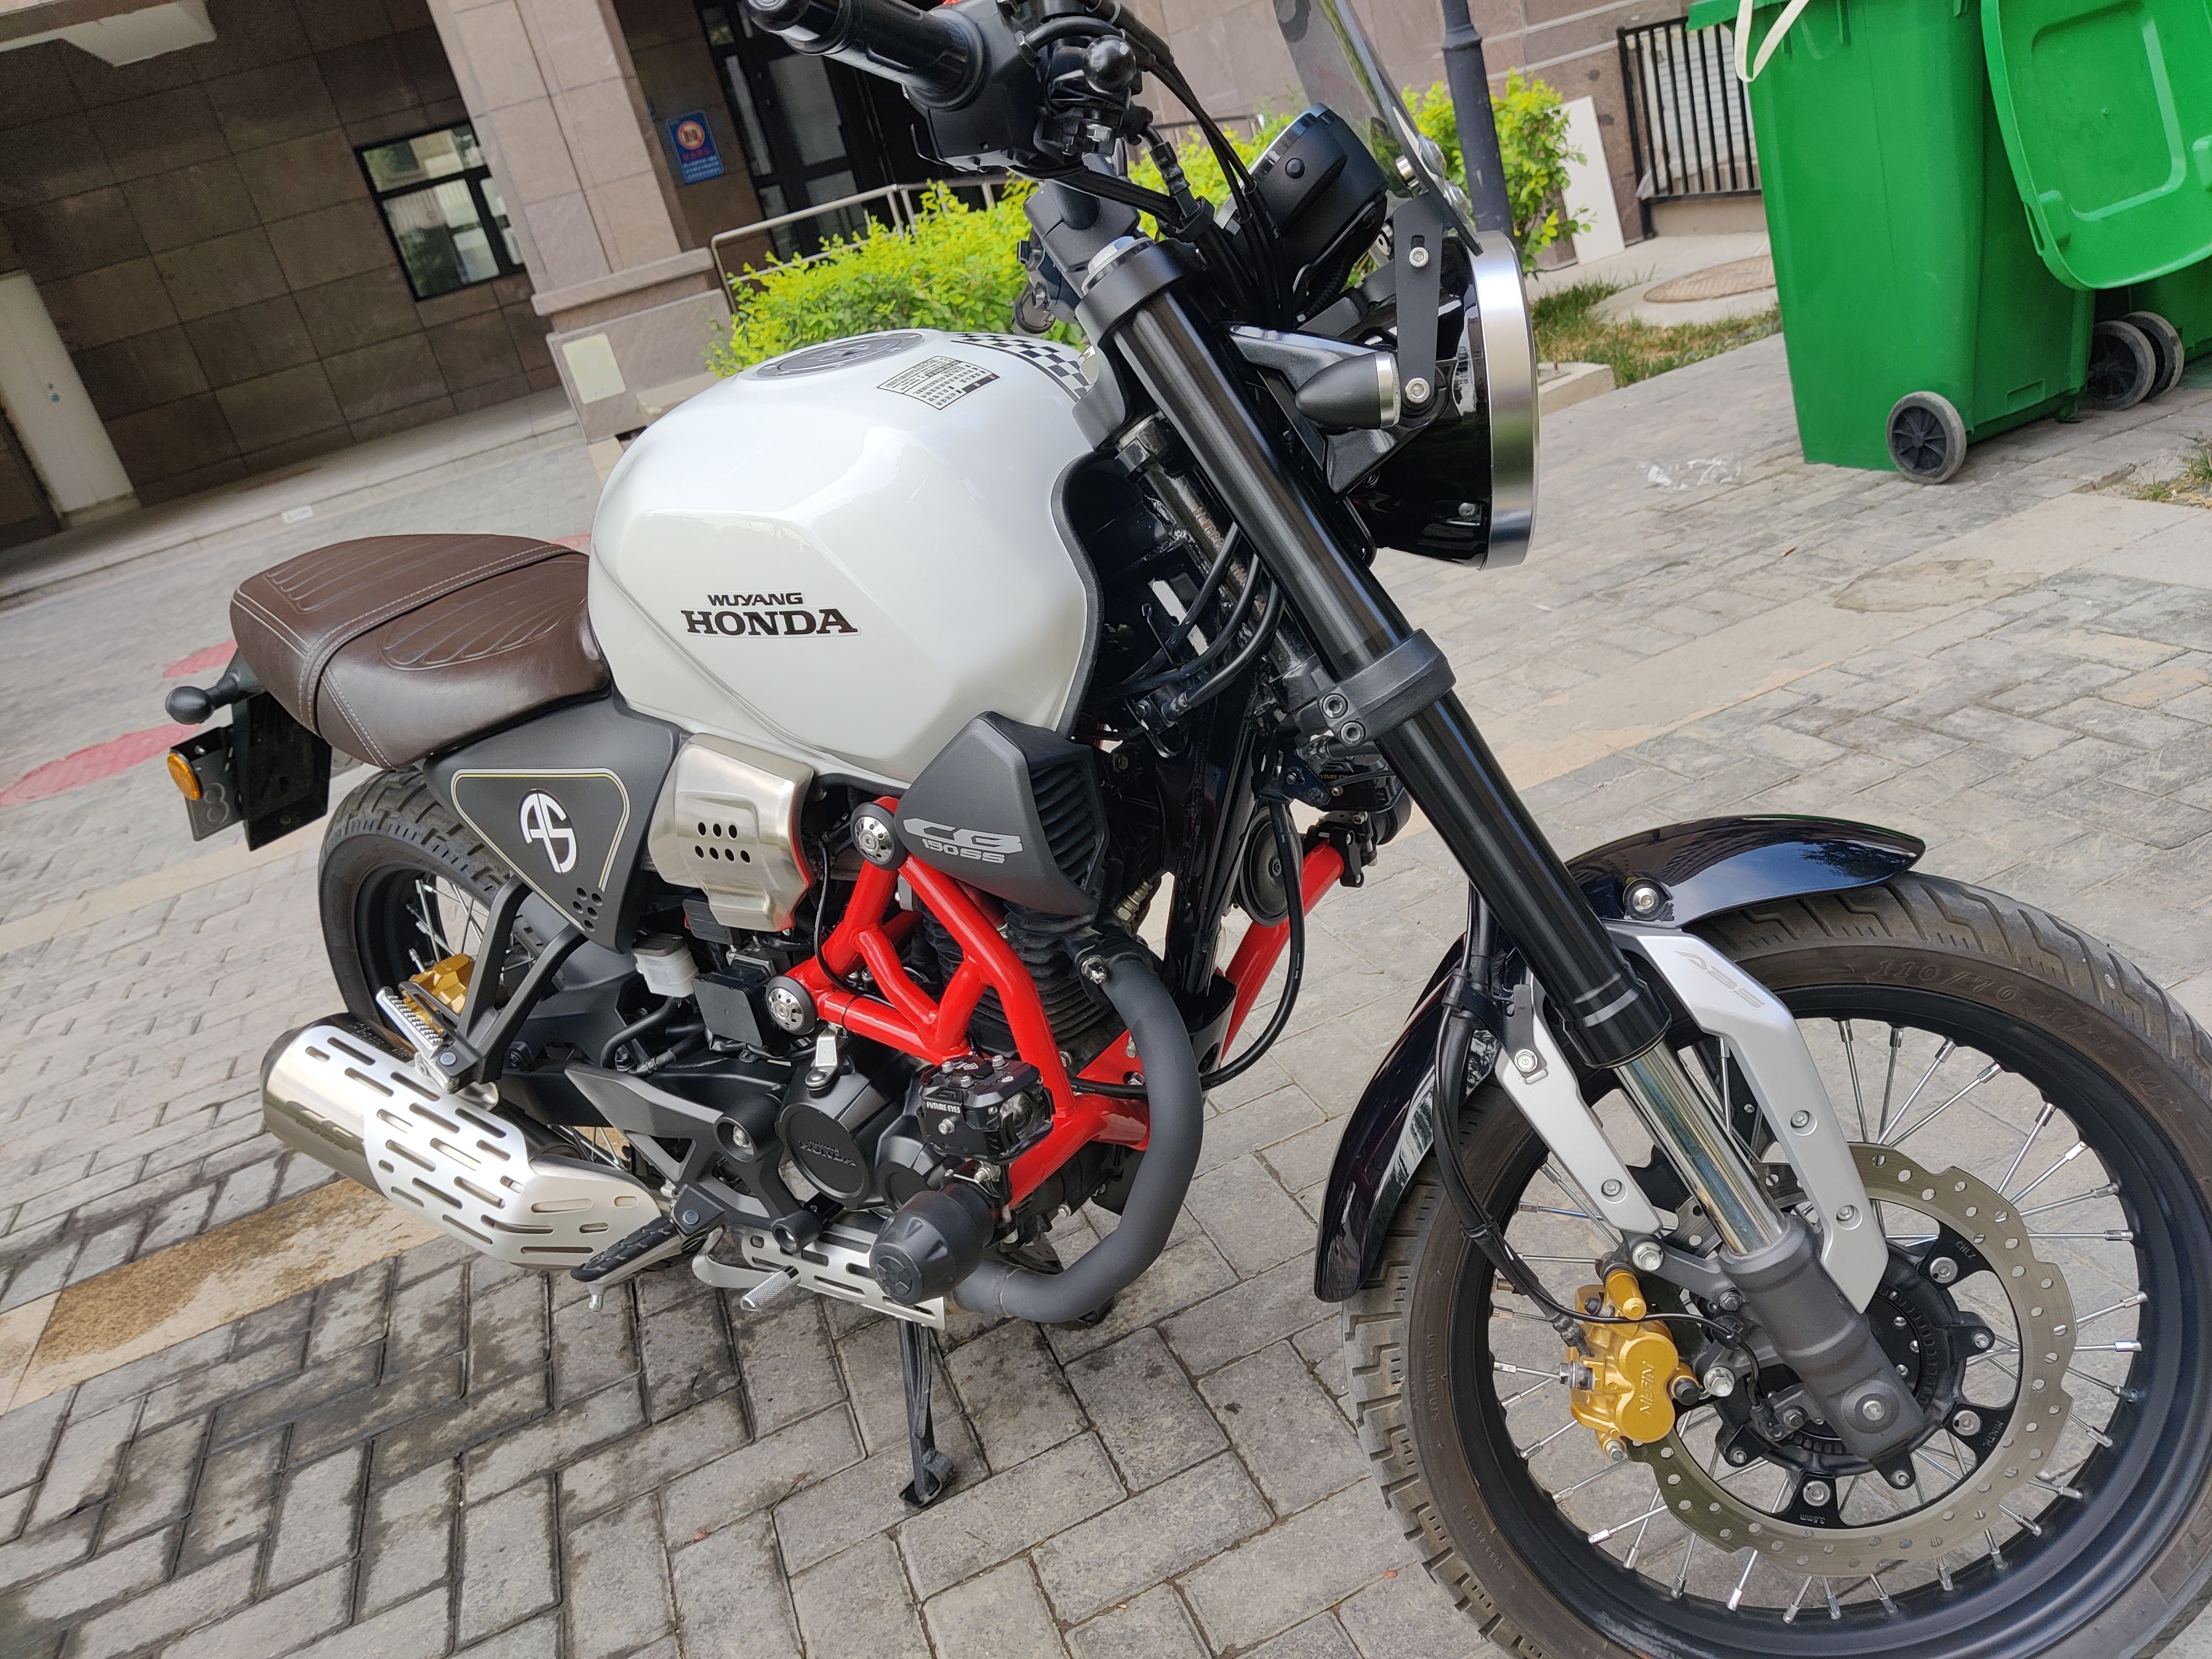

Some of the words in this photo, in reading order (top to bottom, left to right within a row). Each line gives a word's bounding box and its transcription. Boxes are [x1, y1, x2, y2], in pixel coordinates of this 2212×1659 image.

[707, 592, 804, 606] WUYANG
[680, 608, 858, 636] HONDA
[903, 818, 1023, 854] CB
[922, 838, 1005, 864] 190SS
[1674, 950, 1766, 1008] ABS
[927, 1102, 947, 1112] FUTURE
[947, 1105, 961, 1113] EYES
